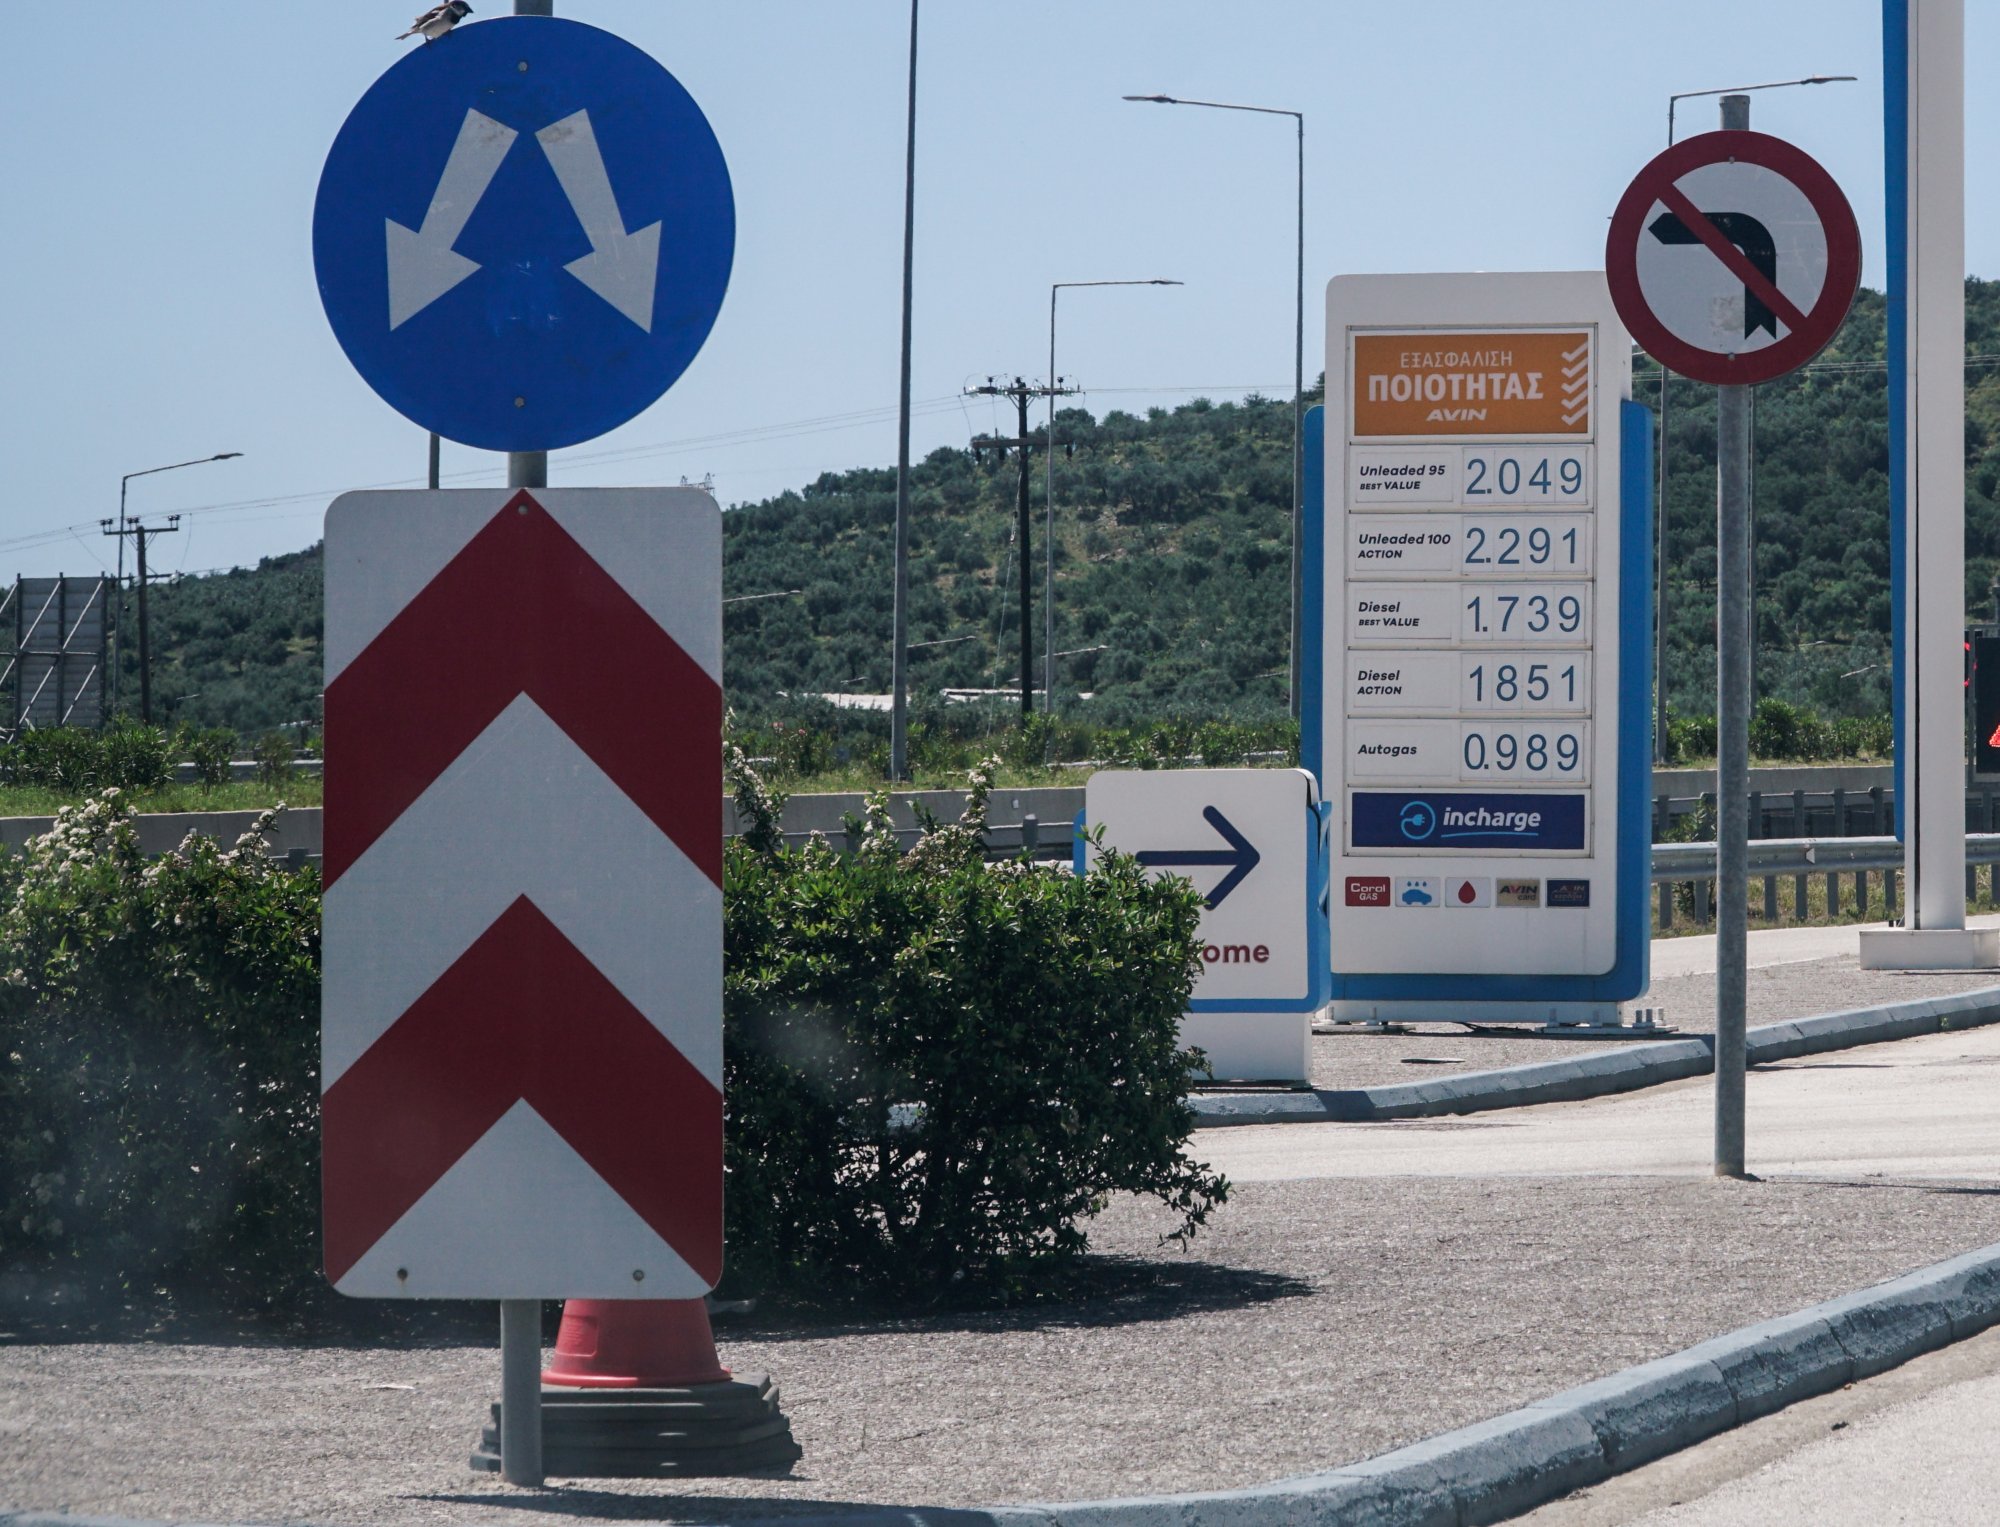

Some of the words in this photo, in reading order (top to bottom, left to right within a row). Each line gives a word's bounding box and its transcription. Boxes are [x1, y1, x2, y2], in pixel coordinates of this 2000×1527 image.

[1400, 351, 1513, 369] ΕΞΑΣΦΑΛΙΣΗ
[1368, 372, 1544, 402] ΠΟΙΟΤΗΤΑΣ
[1425, 408, 1488, 422] AVIN
[1359, 465, 1425, 476] Unleaded
[1429, 465, 1446, 476] 95
[1466, 458, 1582, 495] 2.049
[1359, 482, 1382, 490] BEST
[1384, 481, 1421, 490] VALUE
[1358, 533, 1425, 545] Unleaded
[1428, 533, 1451, 545] 100
[1465, 527, 1576, 564] 2.291
[1357, 549, 1403, 559] ACTION
[1358, 601, 1400, 613] Diesel
[1467, 595, 1581, 632] 1.739
[1383, 618, 1420, 627] VALUE
[1357, 670, 1400, 681] Diesel
[1469, 664, 1575, 702] 1851
[1356, 686, 1402, 695] ACTION
[1357, 744, 1418, 757] Autogas
[1464, 733, 1579, 771] 0.989
[1442, 807, 1541, 831] incharge
[1350, 882, 1386, 893] Coral
[1500, 885, 1538, 894] AVIN
[1359, 892, 1378, 901] GAS
[1200, 944, 1270, 963] ome
